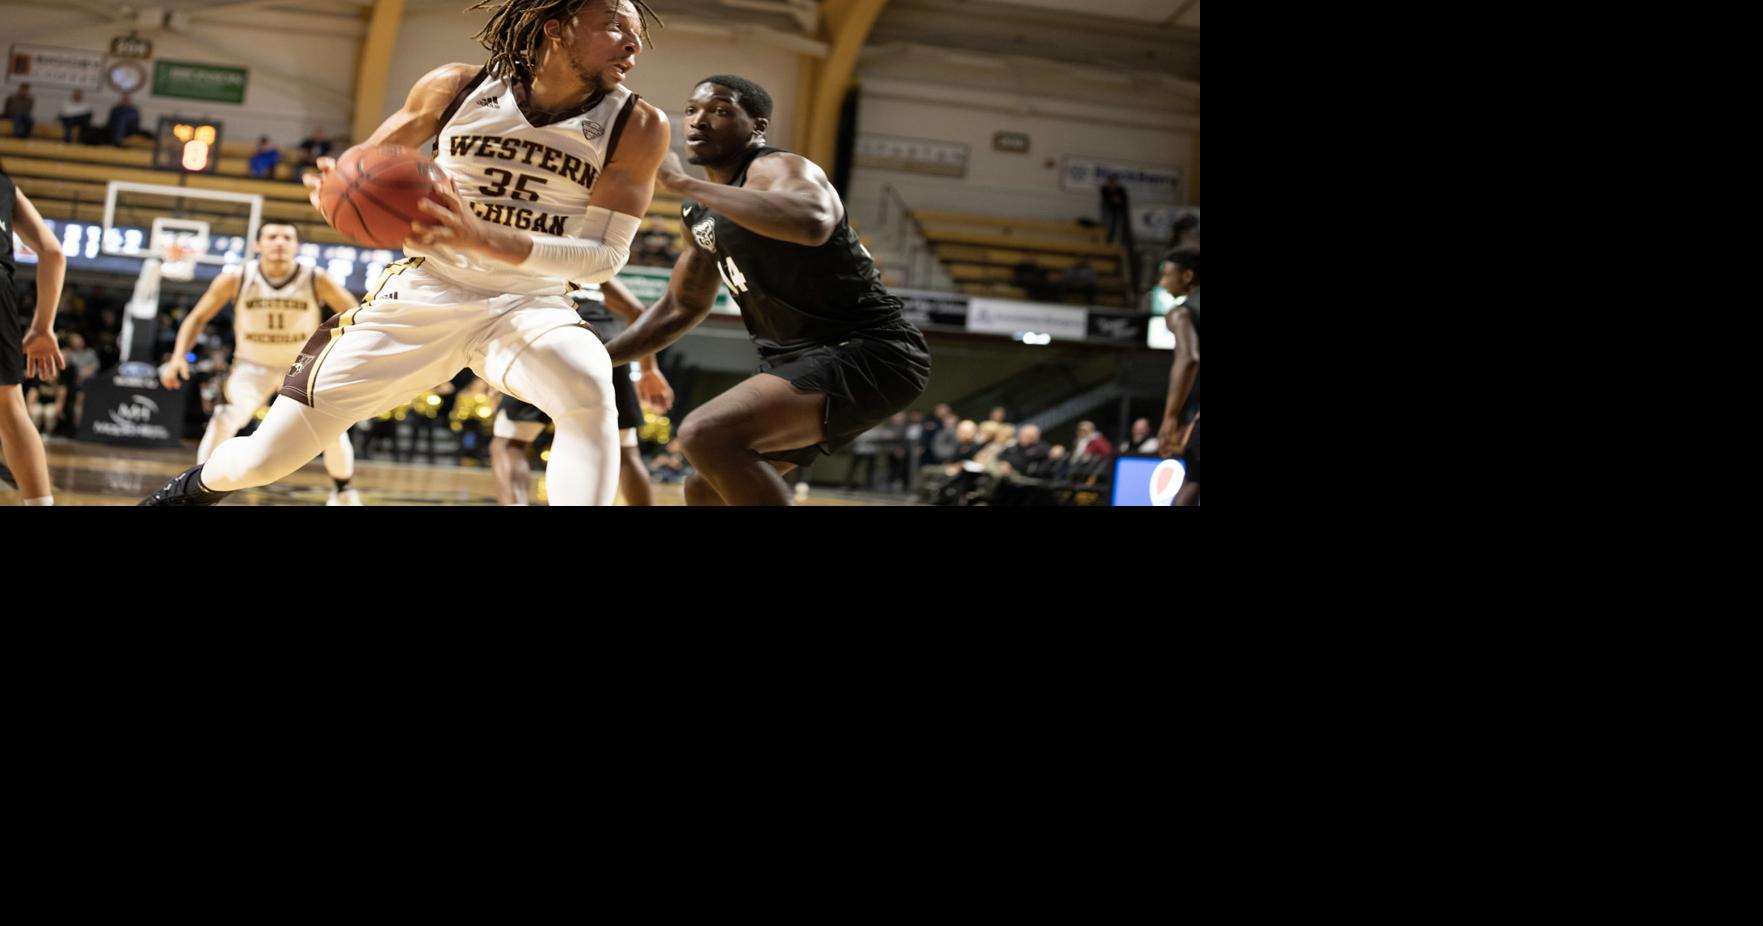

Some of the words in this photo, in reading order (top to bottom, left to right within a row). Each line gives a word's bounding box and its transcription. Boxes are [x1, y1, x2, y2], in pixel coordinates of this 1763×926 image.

[450, 135, 598, 190] WESTERN
[478, 167, 548, 202] 35
[469, 201, 569, 237] HIGAN
[268, 312, 284, 330] 11
